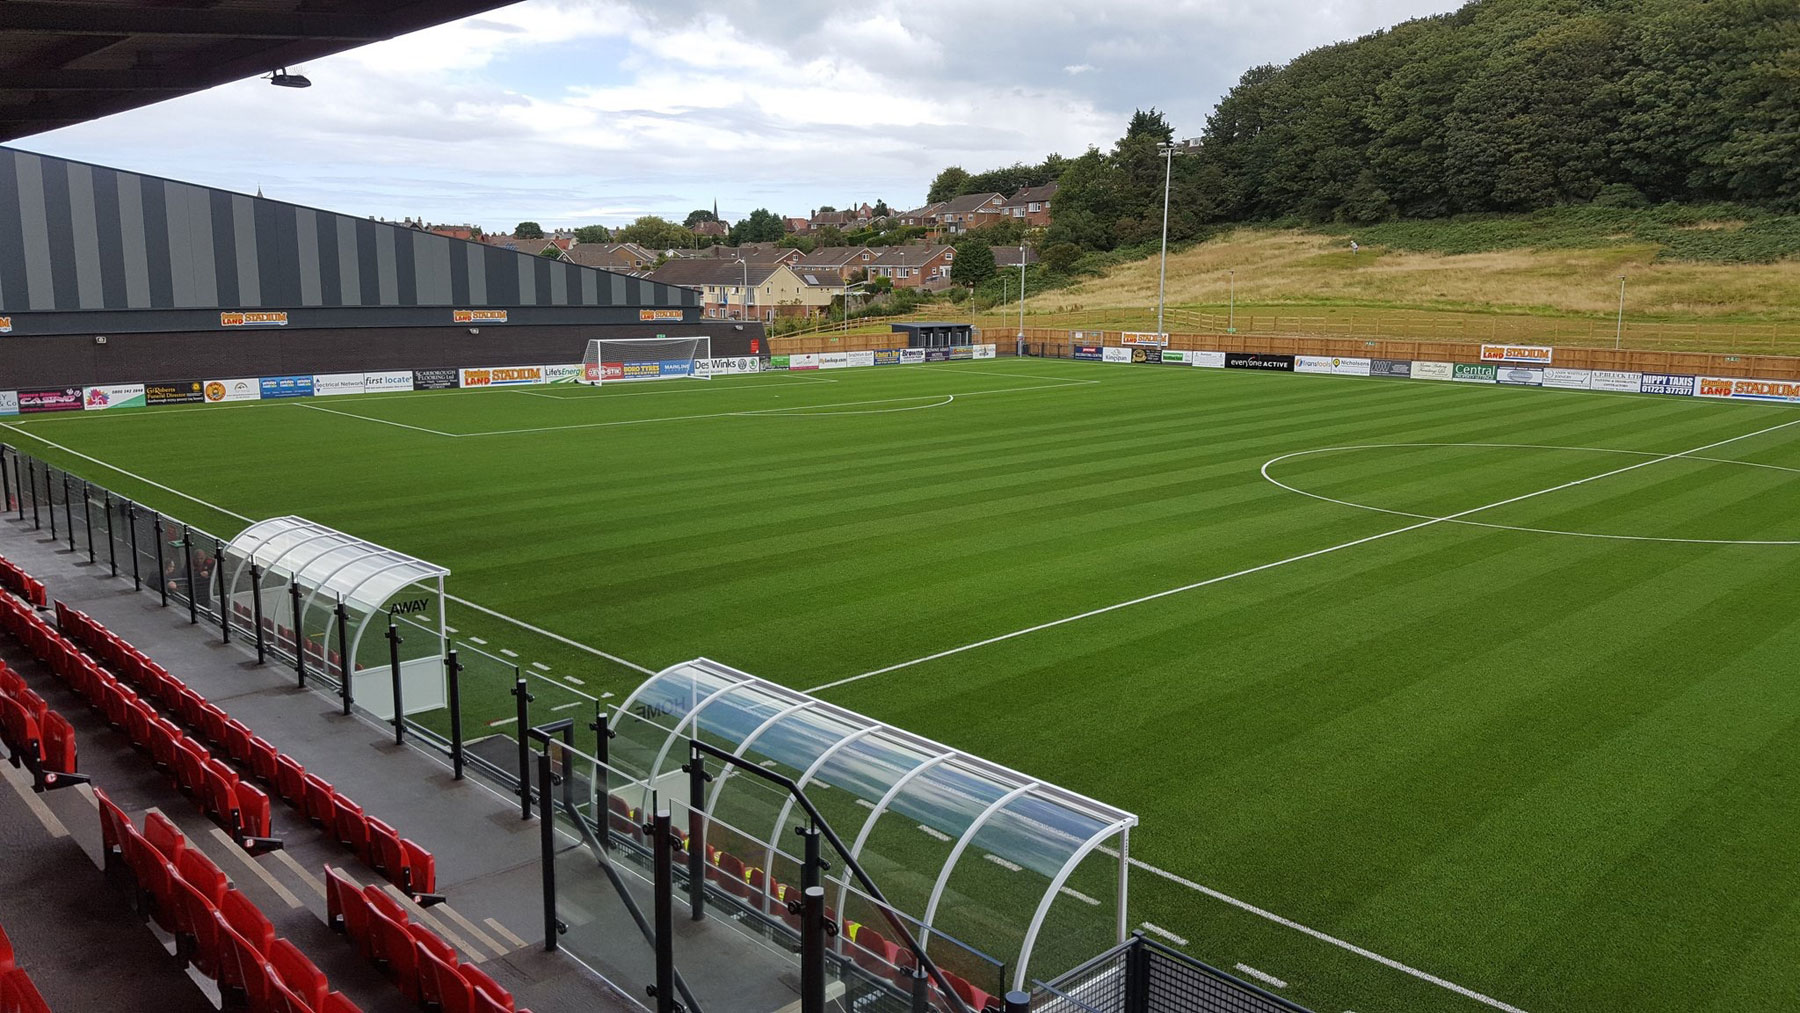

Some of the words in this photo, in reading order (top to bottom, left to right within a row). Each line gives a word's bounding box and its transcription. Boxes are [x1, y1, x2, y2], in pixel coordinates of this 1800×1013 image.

[245, 313, 287, 322] STADIUM
[1105, 354, 1128, 362] Kingspan
[1506, 348, 1549, 358] STADIUM
[695, 361, 709, 370] Des
[711, 358, 736, 368] Winks
[1231, 357, 1262, 367] everyone
[492, 368, 542, 381] STADIUM
[1455, 364, 1496, 375] Central
[365, 377, 383, 386] first
[385, 375, 409, 383] locate
[465, 378, 491, 386] LAND
[1642, 375, 1668, 385] NIPPY
[1669, 376, 1694, 386] TAXIS
[1642, 386, 1665, 394] 01723
[1665, 387, 1693, 395] 377377
[1701, 386, 1732, 396] LAND
[1735, 381, 1800, 397] STADIUM
[389, 598, 429, 615] AWAY
